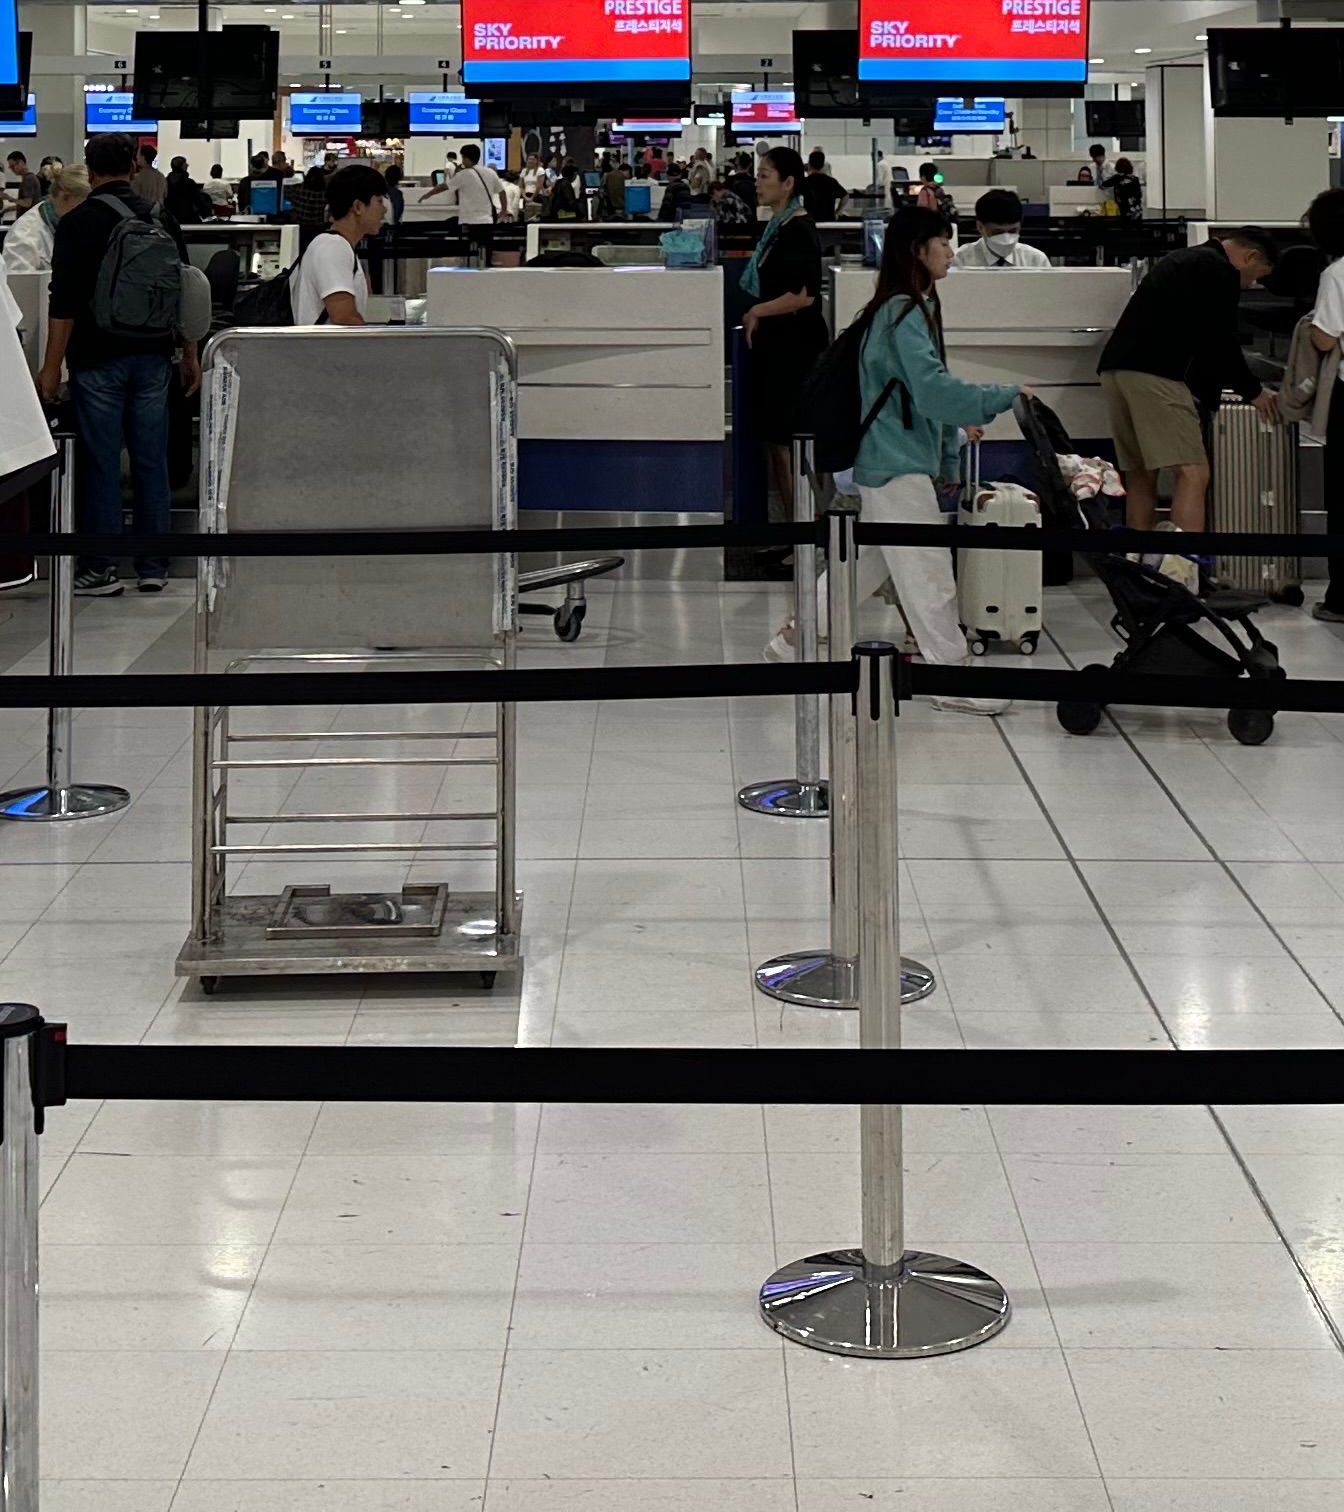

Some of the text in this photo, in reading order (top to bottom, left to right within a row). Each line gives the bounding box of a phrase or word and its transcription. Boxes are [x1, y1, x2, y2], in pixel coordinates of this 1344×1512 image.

[604, 0, 683, 16] PRESTIGE
[1002, 0, 1081, 16] PRESTIGE
[473, 23, 513, 37] SKY
[614, 18, 683, 34] 프레스티지석
[869, 20, 909, 34] SKY
[1010, 19, 1081, 35] 프레스티지석
[473, 36, 563, 50] PRIORITY
[869, 34, 959, 49] PRIORITY
